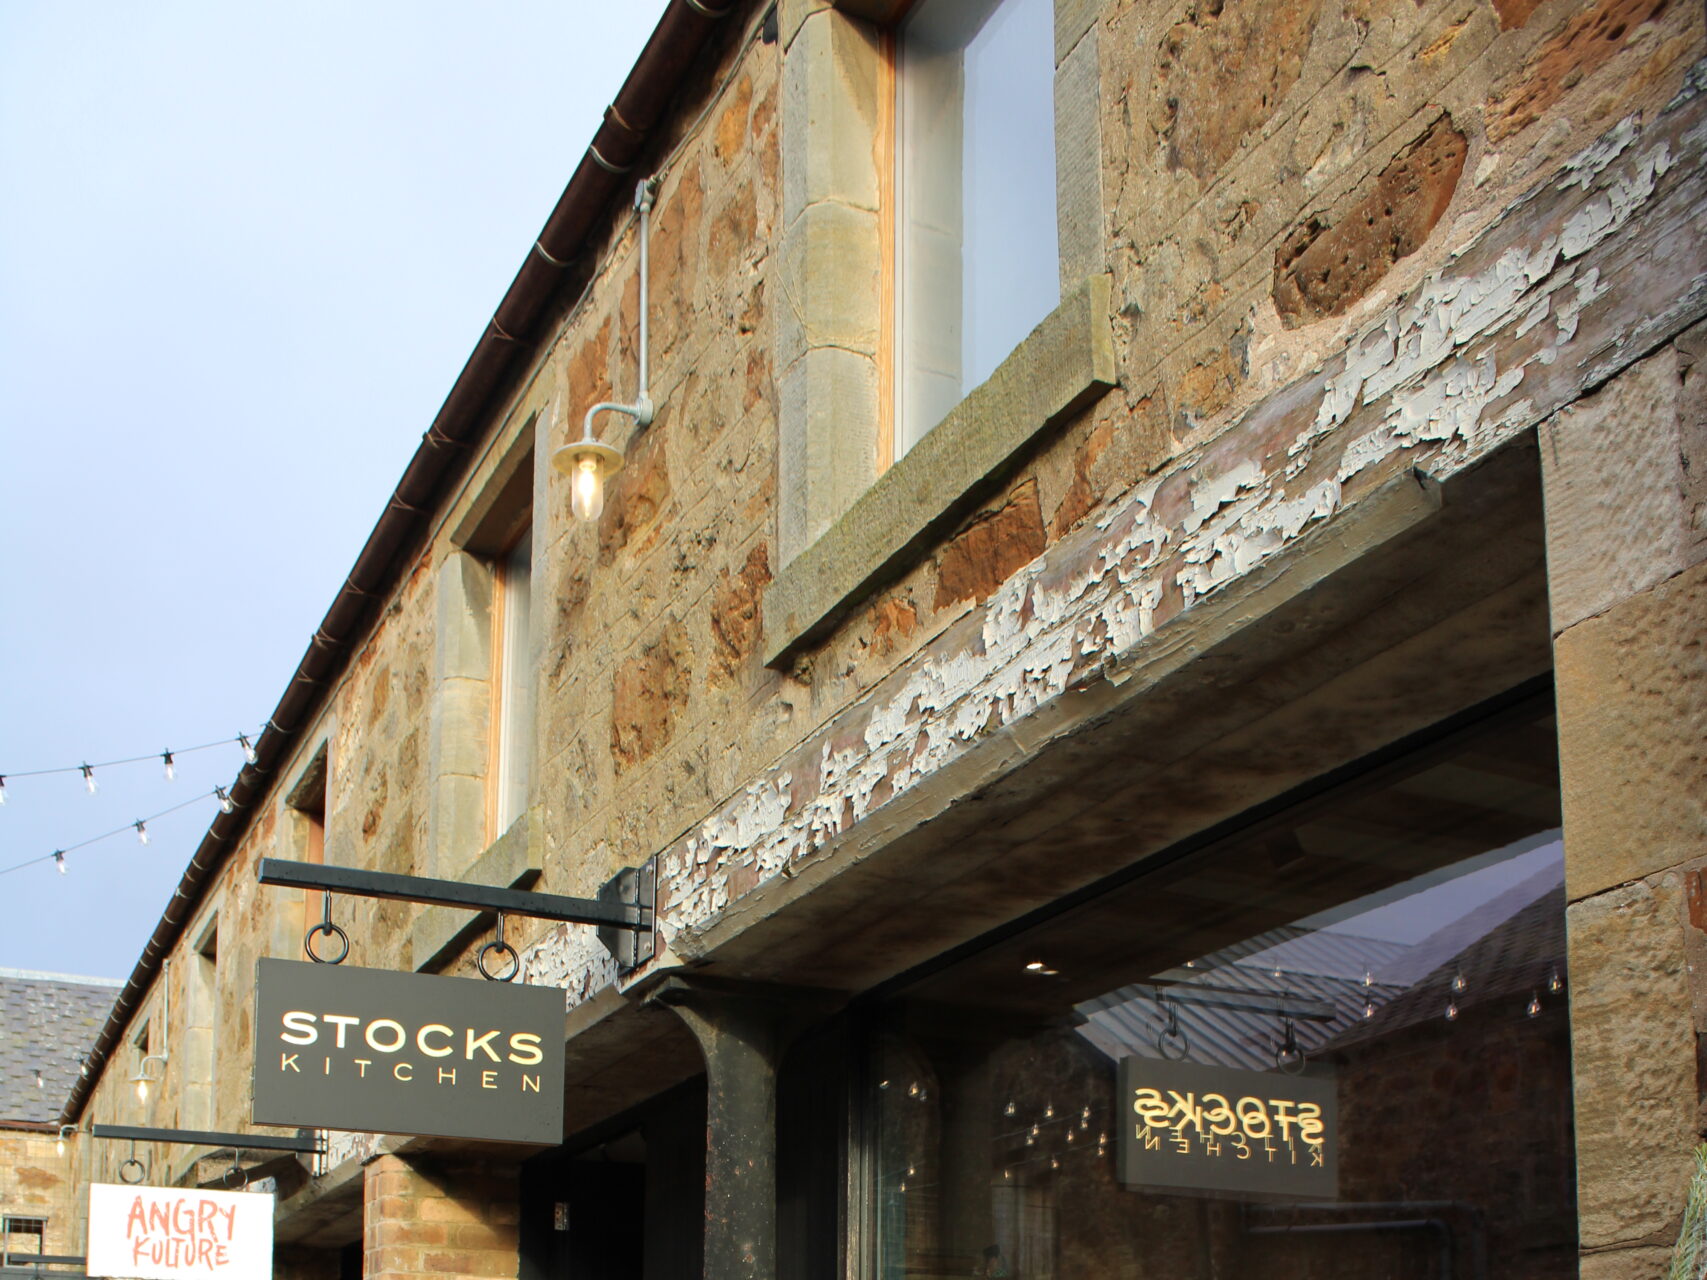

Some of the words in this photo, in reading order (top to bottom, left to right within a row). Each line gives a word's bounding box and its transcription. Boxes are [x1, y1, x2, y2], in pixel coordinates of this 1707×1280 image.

[280, 1011, 543, 1065] STOCKS
[281, 1053, 541, 1092] KITCHEN
[126, 1195, 236, 1243] ANGRY
[133, 1235, 229, 1271] KULTURE
